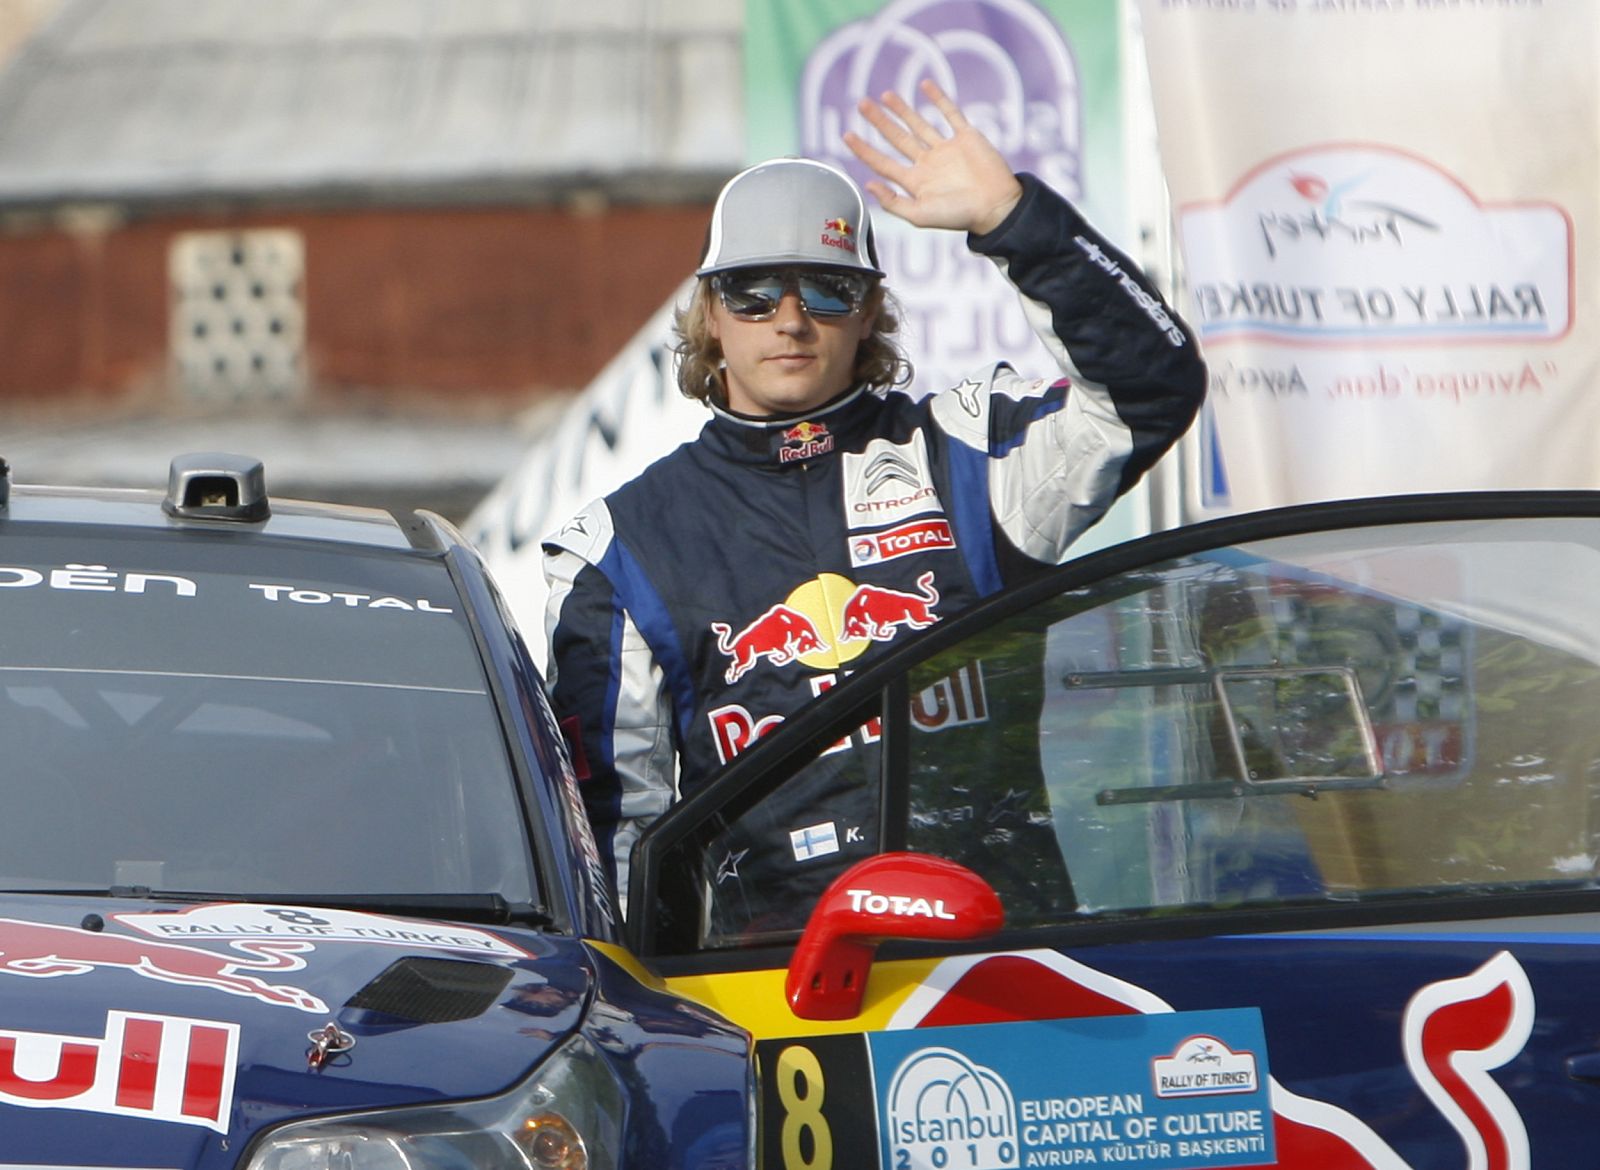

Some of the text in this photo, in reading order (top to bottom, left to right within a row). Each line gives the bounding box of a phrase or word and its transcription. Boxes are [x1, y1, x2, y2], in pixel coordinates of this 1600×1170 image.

[821, 233, 844, 249] Red
[779, 437, 834, 464] Red Bull
[880, 530, 951, 551] TOTAL
[249, 583, 453, 614] TOTAL
[264, 909, 330, 925] 8
[847, 889, 956, 920] TOTAL
[158, 923, 494, 950] RALLY OF TURKEY
[1162, 1071, 1253, 1089] RALLY OF TURKEY
[777, 1045, 833, 1170] 8
[1020, 1094, 1143, 1122] EUROPEAN
[1022, 1110, 1263, 1147] CAPITAL OF CULTURE
[1026, 1148, 1098, 1169] AVRUPA
[1103, 1140, 1172, 1161] KÜLTÜR
